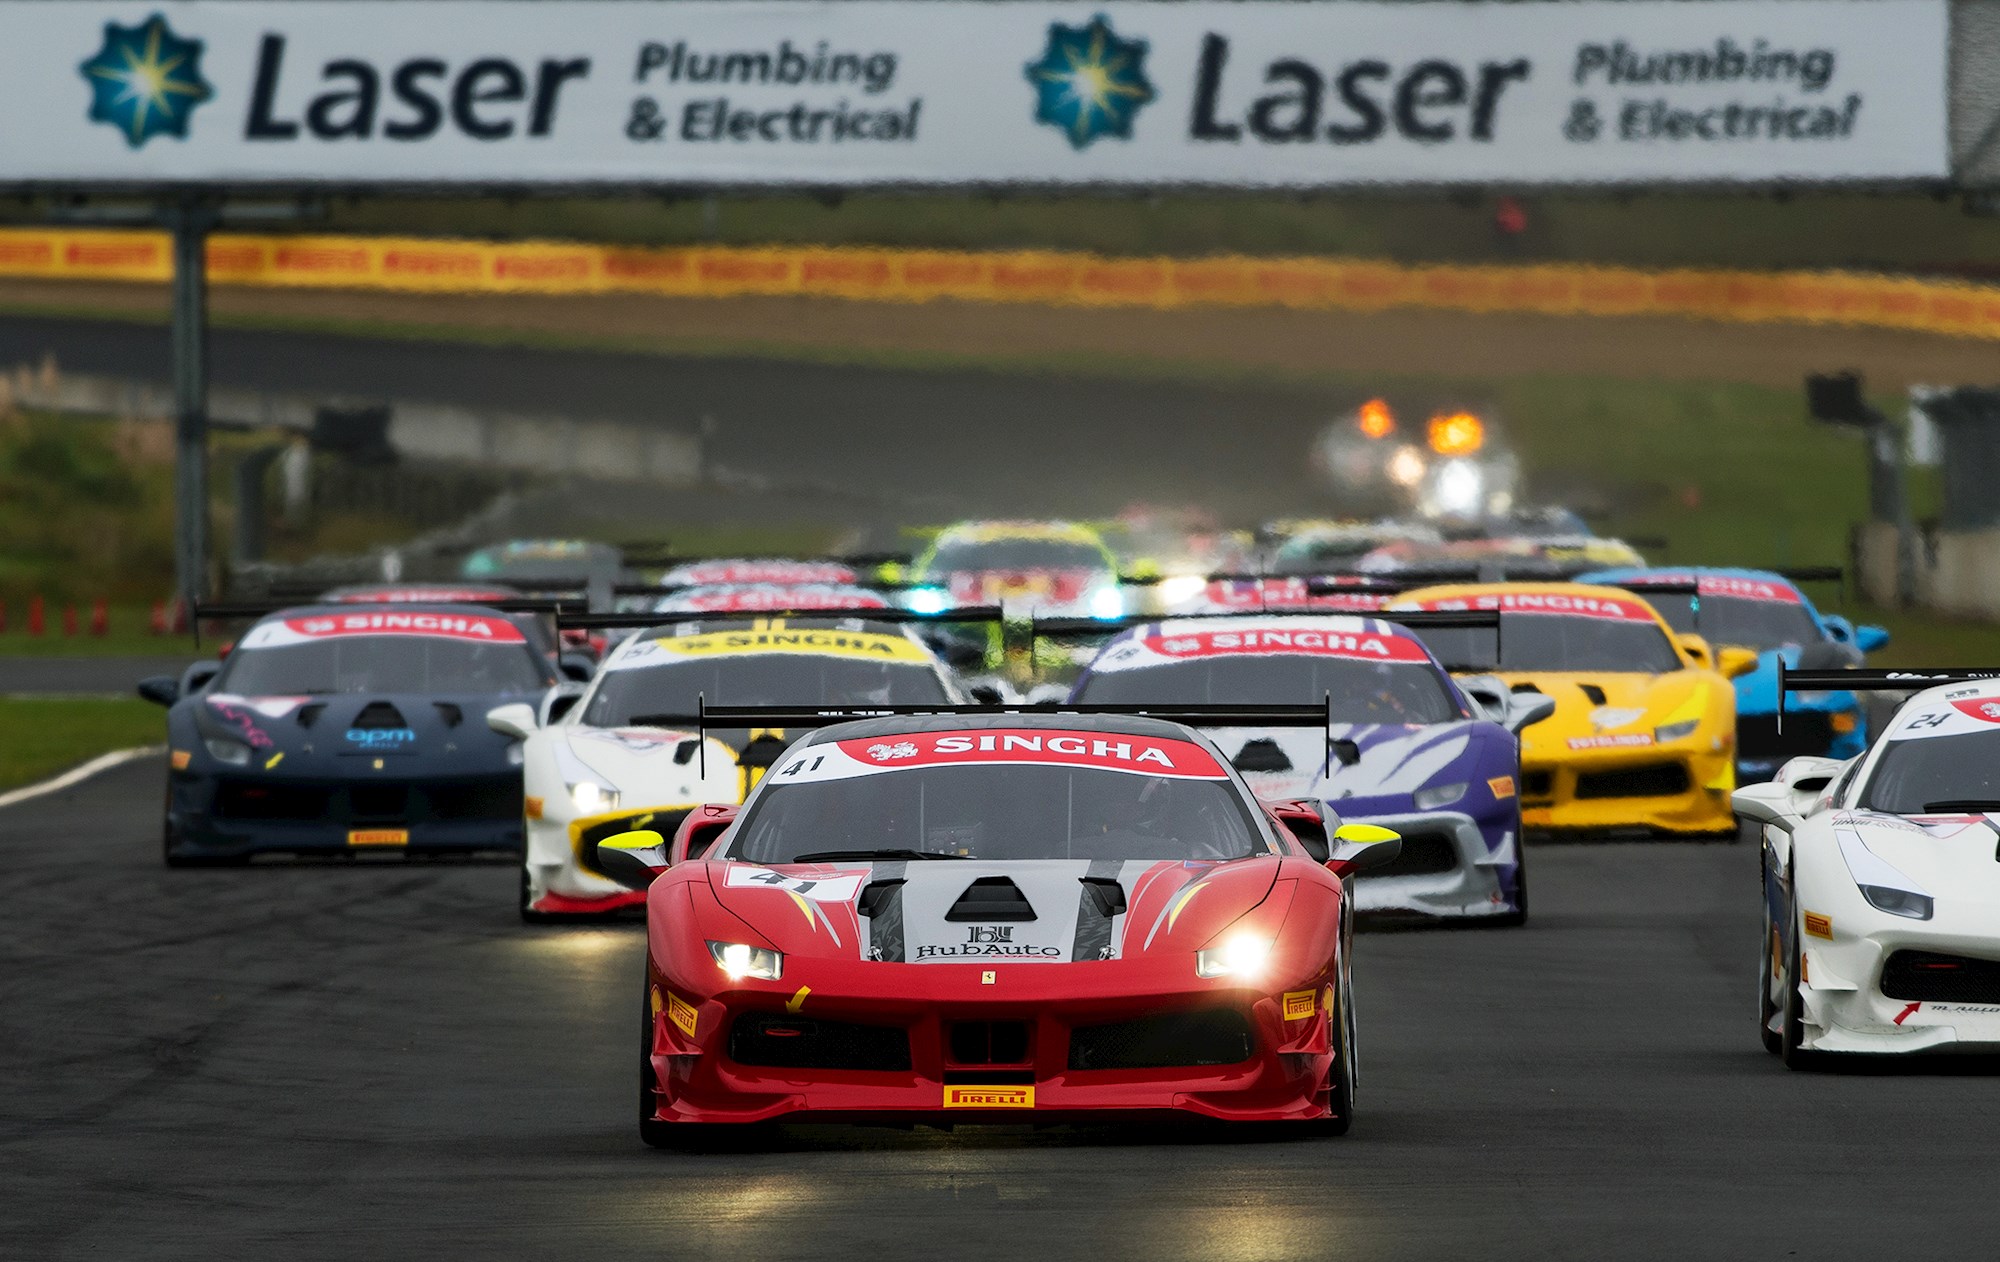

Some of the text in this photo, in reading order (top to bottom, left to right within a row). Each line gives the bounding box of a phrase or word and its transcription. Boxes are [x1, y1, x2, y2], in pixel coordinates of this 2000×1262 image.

[632, 40, 898, 94] Plumbing
[1573, 38, 1835, 92] Plumbing
[244, 33, 590, 143] Laser
[1188, 32, 1530, 143] Laser
[625, 96, 922, 141] & Electrical
[1562, 93, 1862, 142] & Electrical
[1477, 595, 1624, 616] SINGHA
[344, 615, 493, 637] SINGHA
[726, 634, 894, 654] SINGHA
[1211, 632, 1391, 655] SINGHA
[1905, 713, 1953, 730] 24
[345, 728, 415, 745] apm
[933, 735, 1176, 769] SINGHA
[781, 755, 825, 777] 41
[749, 872, 817, 894] 41
[916, 943, 1061, 959] HubAuto
[1286, 994, 1314, 1015] PIRELLI
[951, 1089, 1027, 1104] PIRELLI
